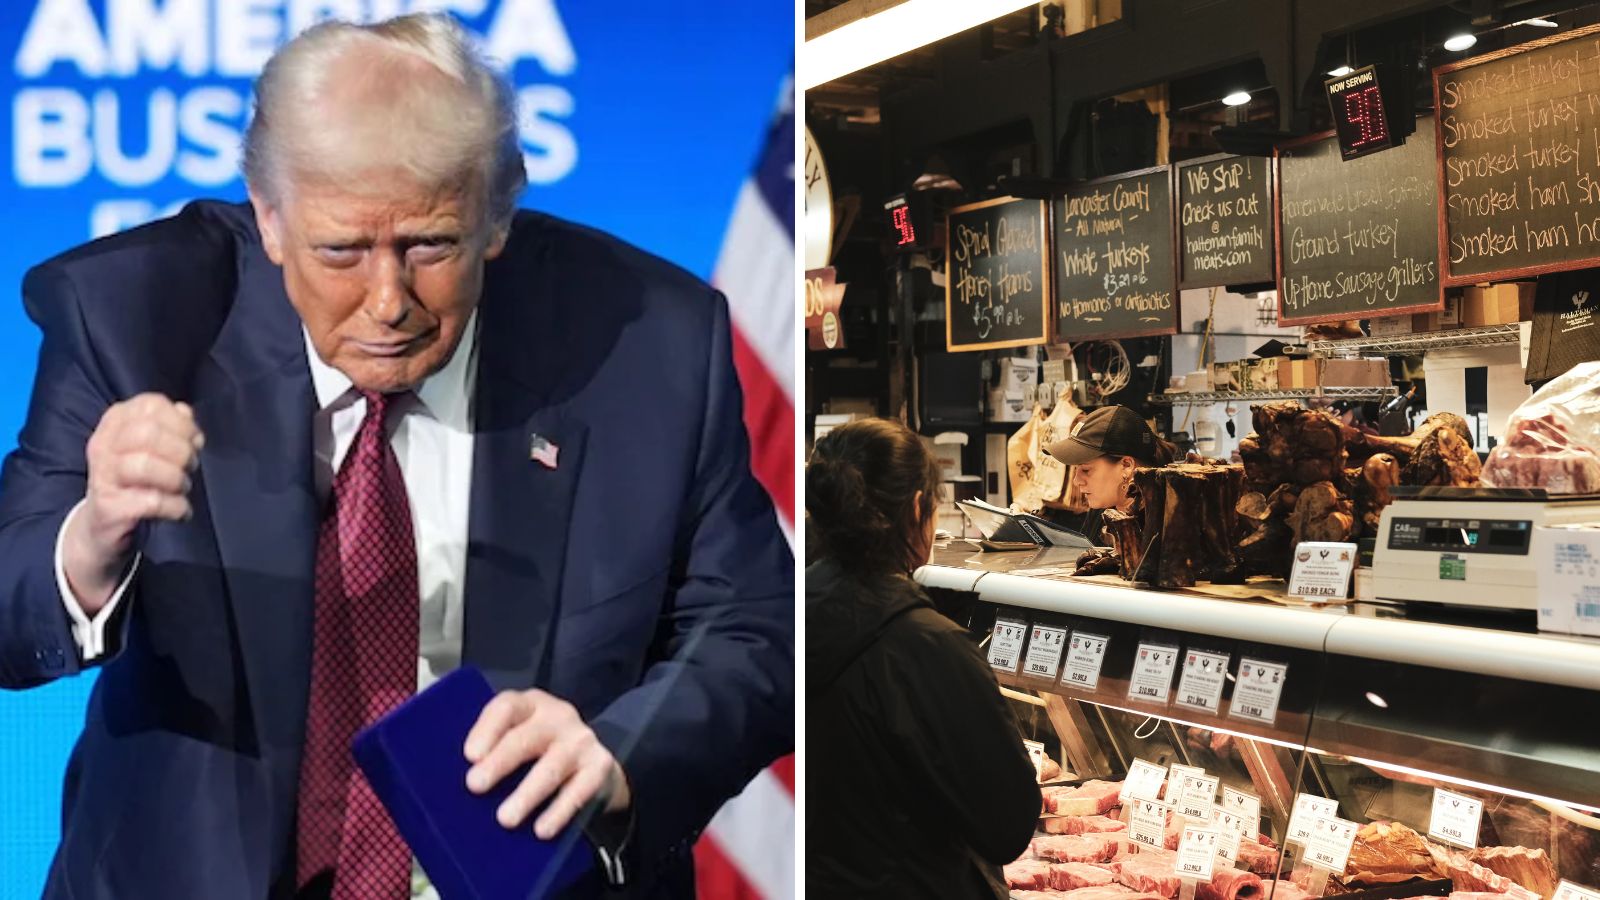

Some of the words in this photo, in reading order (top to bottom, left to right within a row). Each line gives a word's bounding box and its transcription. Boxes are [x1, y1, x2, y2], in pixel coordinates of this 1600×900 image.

[14, 0, 577, 77] AMEA
[1330, 82, 1345, 94] NOW
[1346, 72, 1373, 88] SERVING
[1443, 64, 1519, 109] Smoked
[1519, 50, 1583, 93] turkey
[1443, 106, 1517, 148] Smoked
[1521, 96, 1579, 132] turkey
[1187, 167, 1209, 194] We
[1446, 145, 1519, 187] Smoked
[1523, 137, 1580, 176] turkey
[1064, 189, 1111, 223] Lancaster
[1113, 181, 1149, 212] County
[1183, 200, 1215, 226] Check
[1218, 201, 1232, 217] us
[1448, 182, 1520, 223] Smoked
[1528, 176, 1570, 210] ham
[1063, 245, 1098, 277] Whole
[1194, 250, 1251, 270] meats.com
[1290, 227, 1340, 264] Ground
[1450, 224, 1518, 264] Smoked
[1525, 221, 1569, 252] ham
[1387, 258, 1435, 302] grillers
[1319, 587, 1336, 596] EACH
